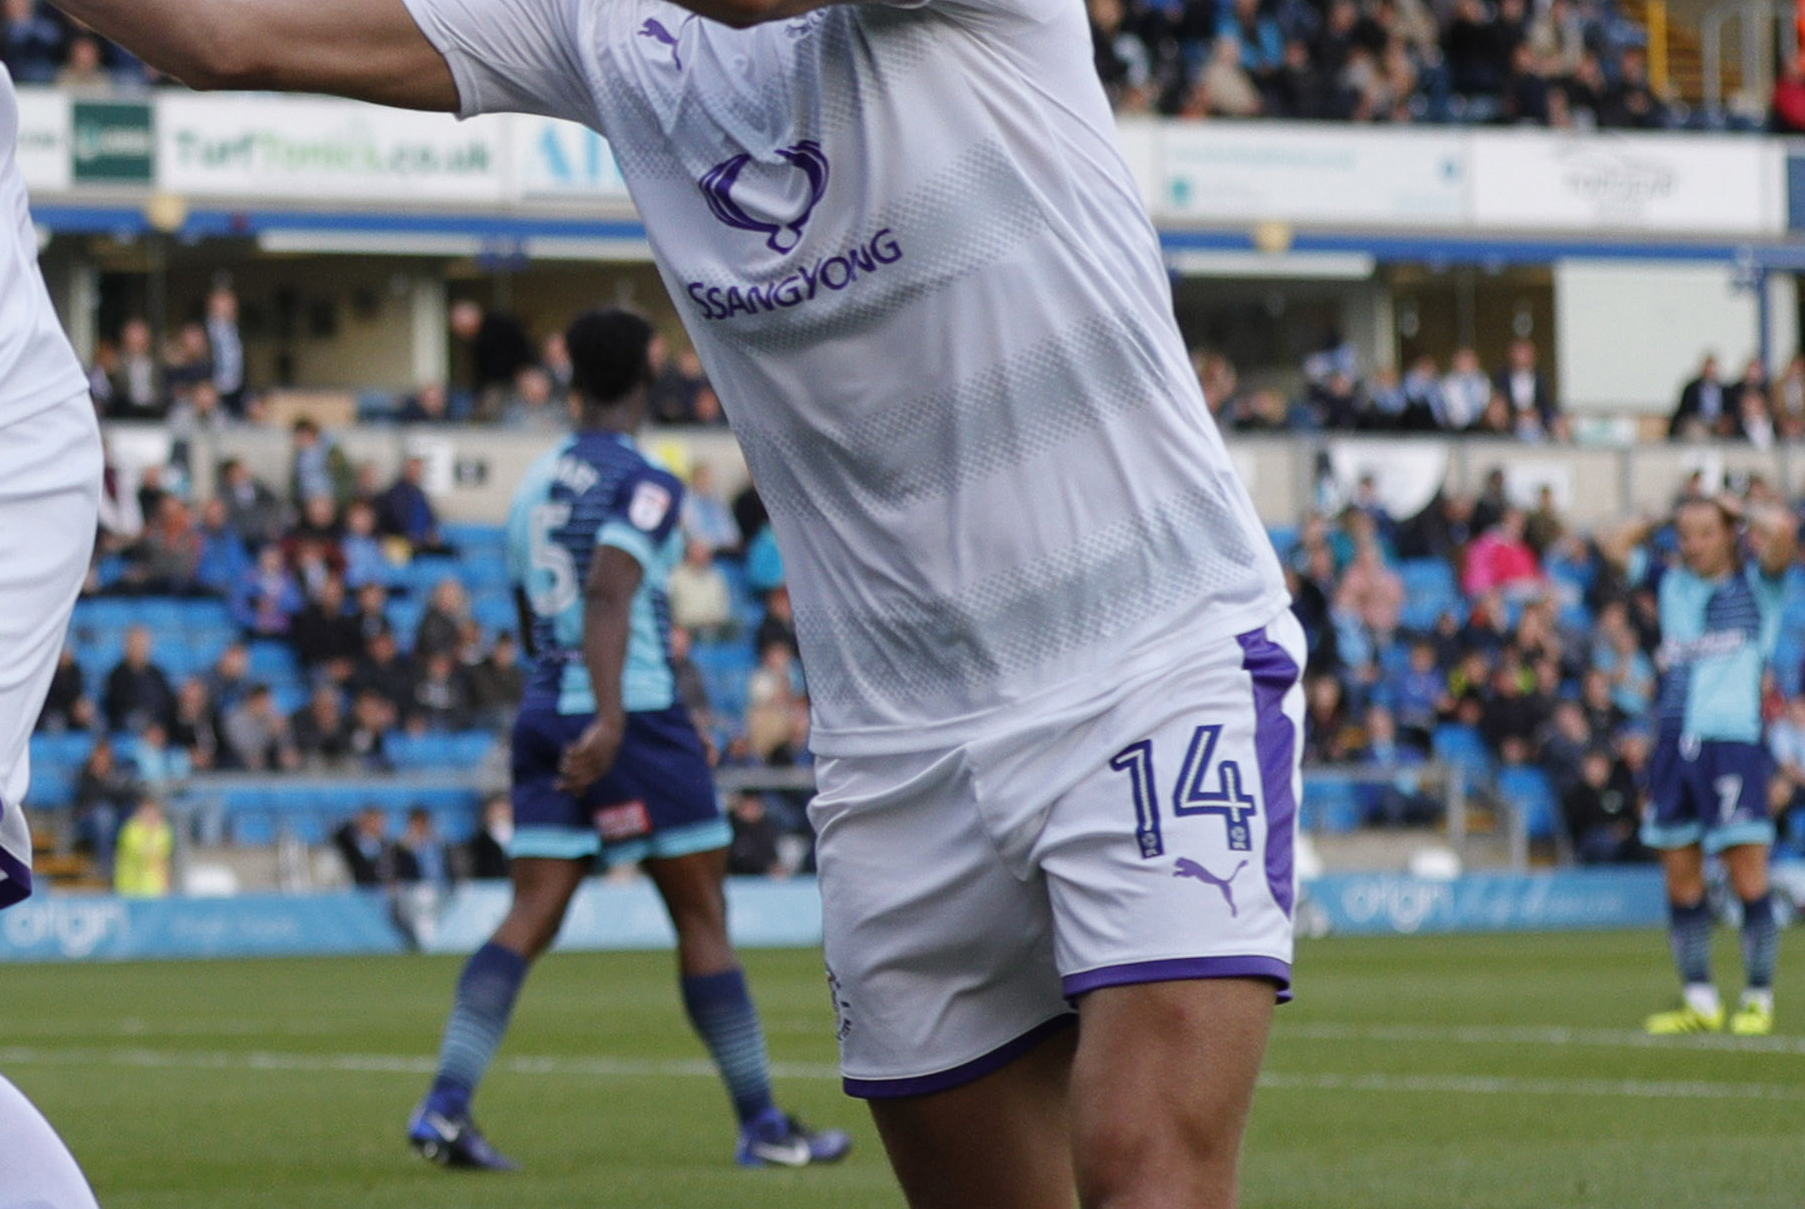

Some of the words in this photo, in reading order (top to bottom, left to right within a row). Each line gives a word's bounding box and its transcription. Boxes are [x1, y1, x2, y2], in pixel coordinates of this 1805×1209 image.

[687, 228, 903, 320] SSANGYONG
[529, 502, 580, 617] 5
[1109, 724, 1258, 860] 14
